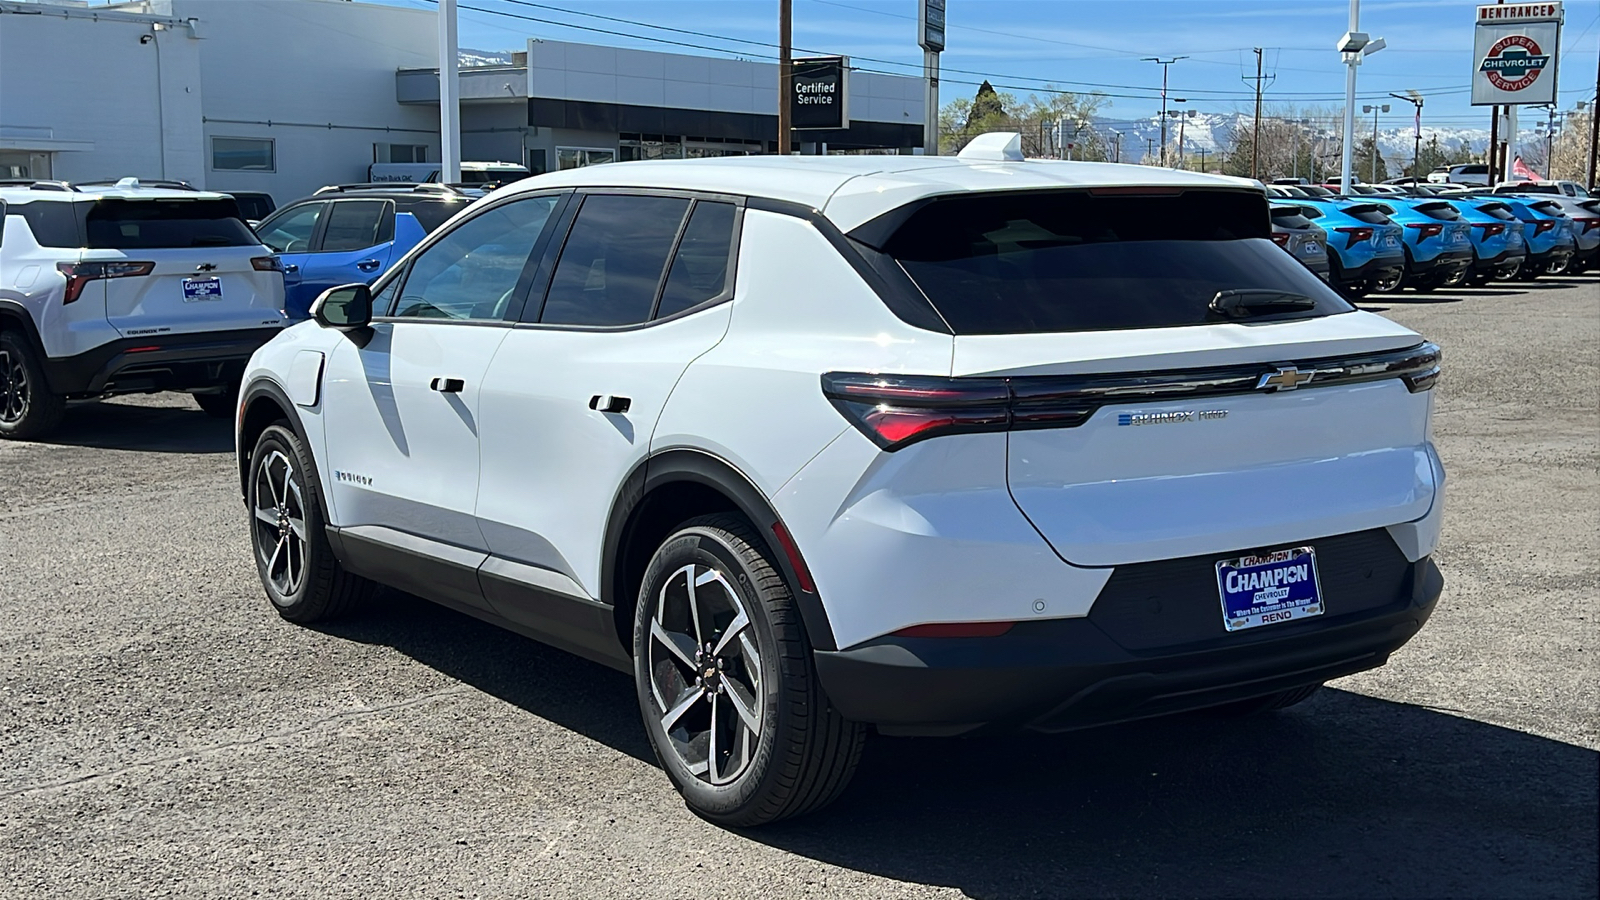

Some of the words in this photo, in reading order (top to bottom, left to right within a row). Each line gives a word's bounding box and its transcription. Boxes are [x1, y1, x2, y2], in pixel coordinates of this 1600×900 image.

[1488, 5, 1547, 19] ENTRANCE
[1494, 37, 1535, 52] SUPER
[1483, 59, 1545, 68] CHEVROLET
[795, 82, 836, 93] Certified
[1490, 72, 1537, 91] SERVICE
[797, 94, 833, 105] Service
[185, 282, 219, 290] CHAMPION
[1118, 410, 1195, 426] EQUINOX
[1243, 551, 1290, 567] CHAMPION
[1226, 563, 1308, 594] CHAMPION
[1254, 588, 1288, 601] CHEVROLET
[1261, 610, 1292, 624] RENO
